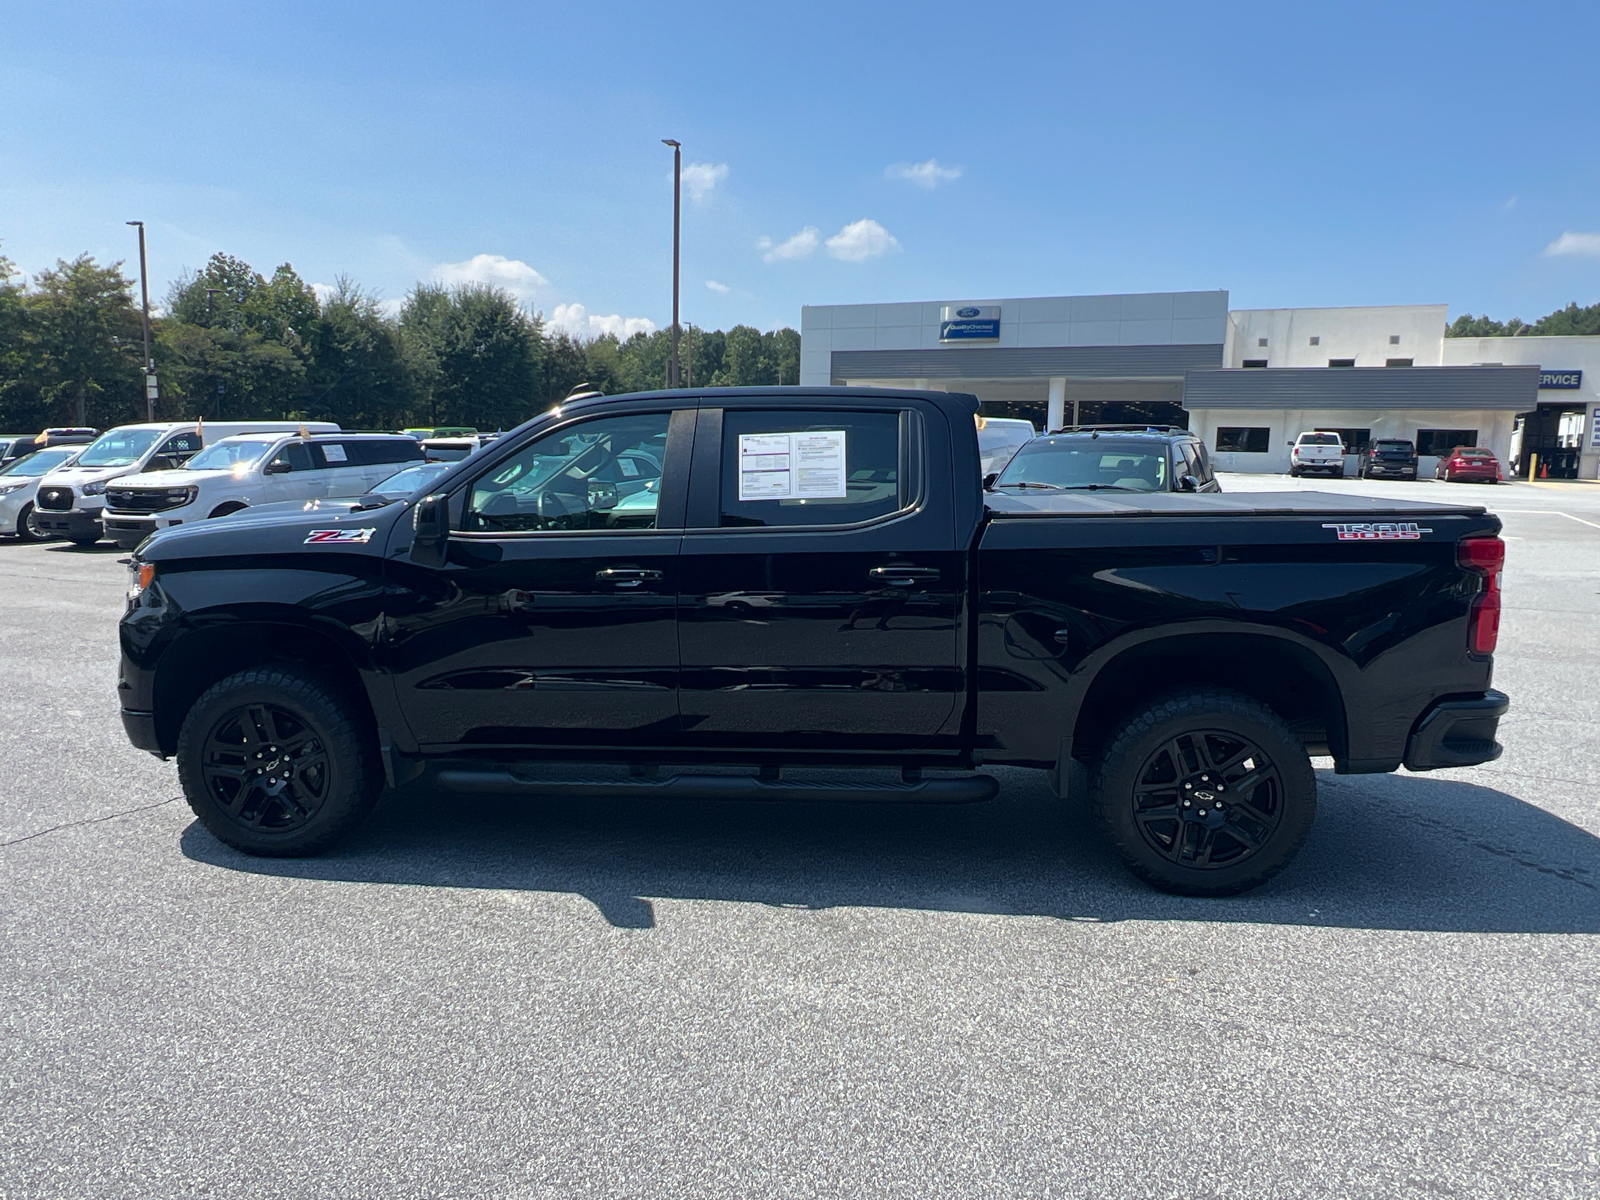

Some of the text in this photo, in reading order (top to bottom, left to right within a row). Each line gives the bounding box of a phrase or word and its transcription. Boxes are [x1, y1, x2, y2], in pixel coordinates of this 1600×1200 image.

[1538, 374, 1579, 385] ERVICE
[1322, 523, 1433, 533] TRAIL
[303, 527, 377, 545] Z71
[1337, 531, 1421, 541] BOSS
